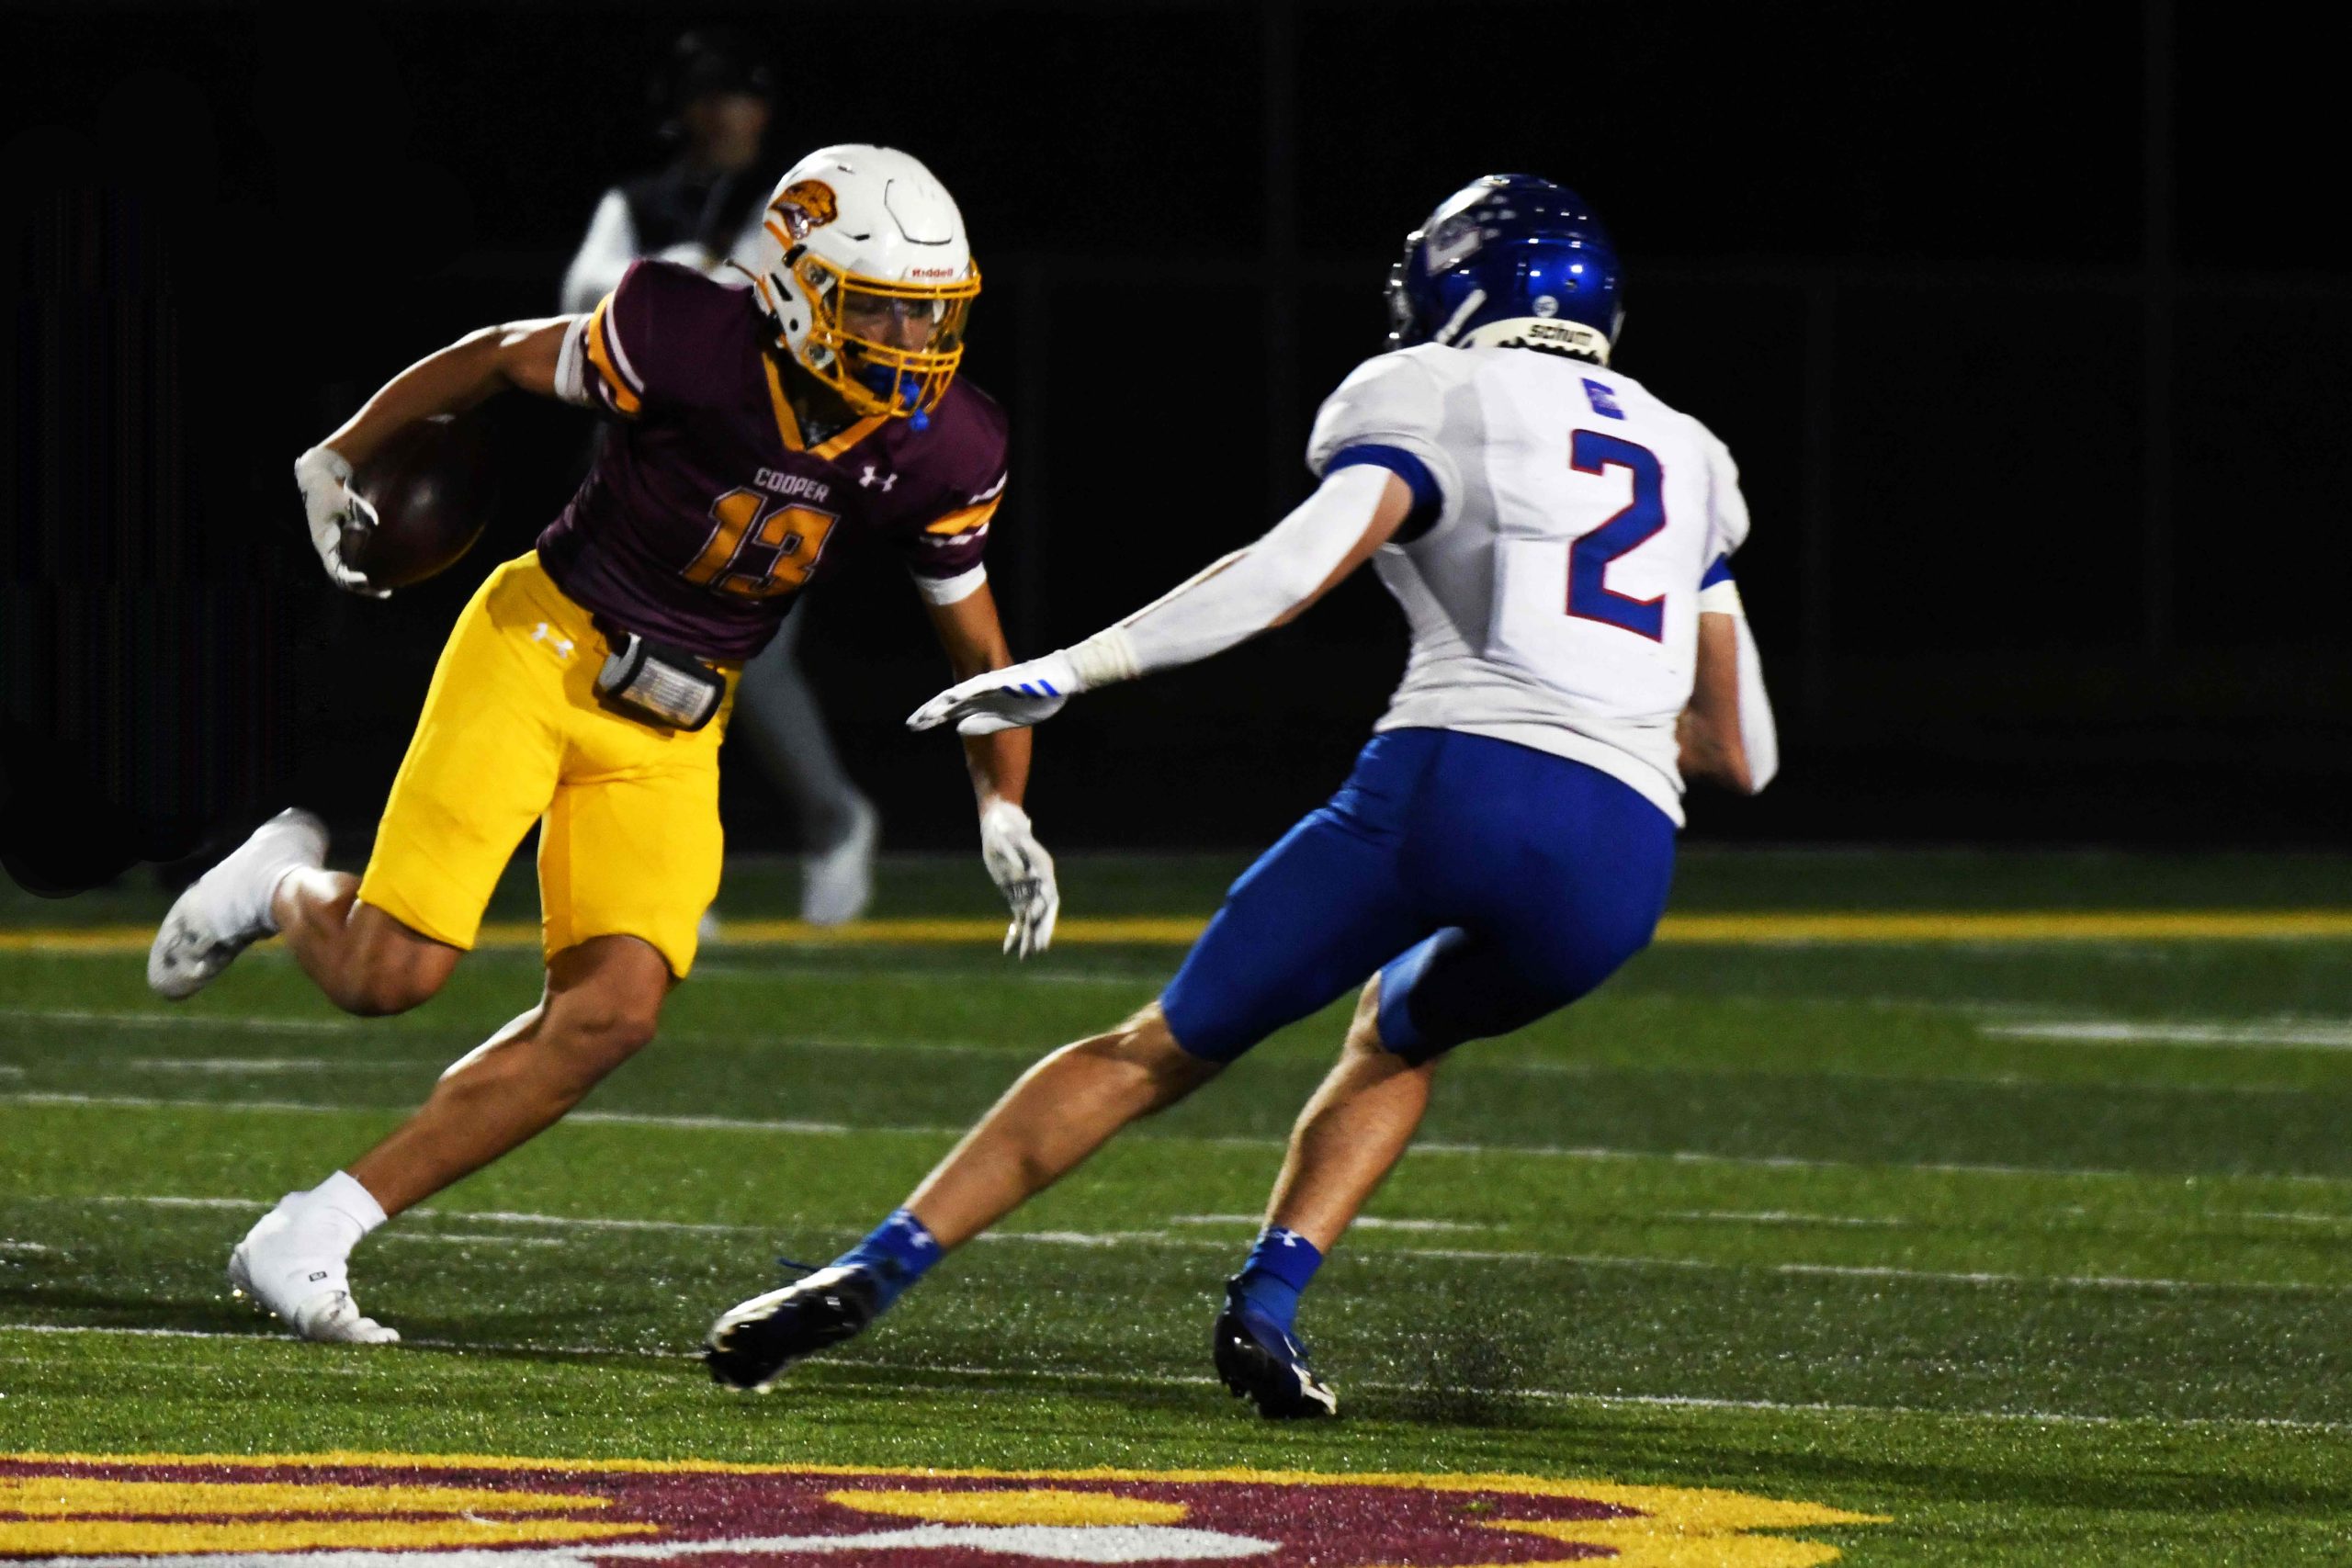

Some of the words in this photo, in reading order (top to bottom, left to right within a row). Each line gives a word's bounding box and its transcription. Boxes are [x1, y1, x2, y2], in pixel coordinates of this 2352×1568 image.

[677, 485, 842, 601] 13
[753, 467, 831, 503] COOPER
[1564, 427, 1668, 644] 2
